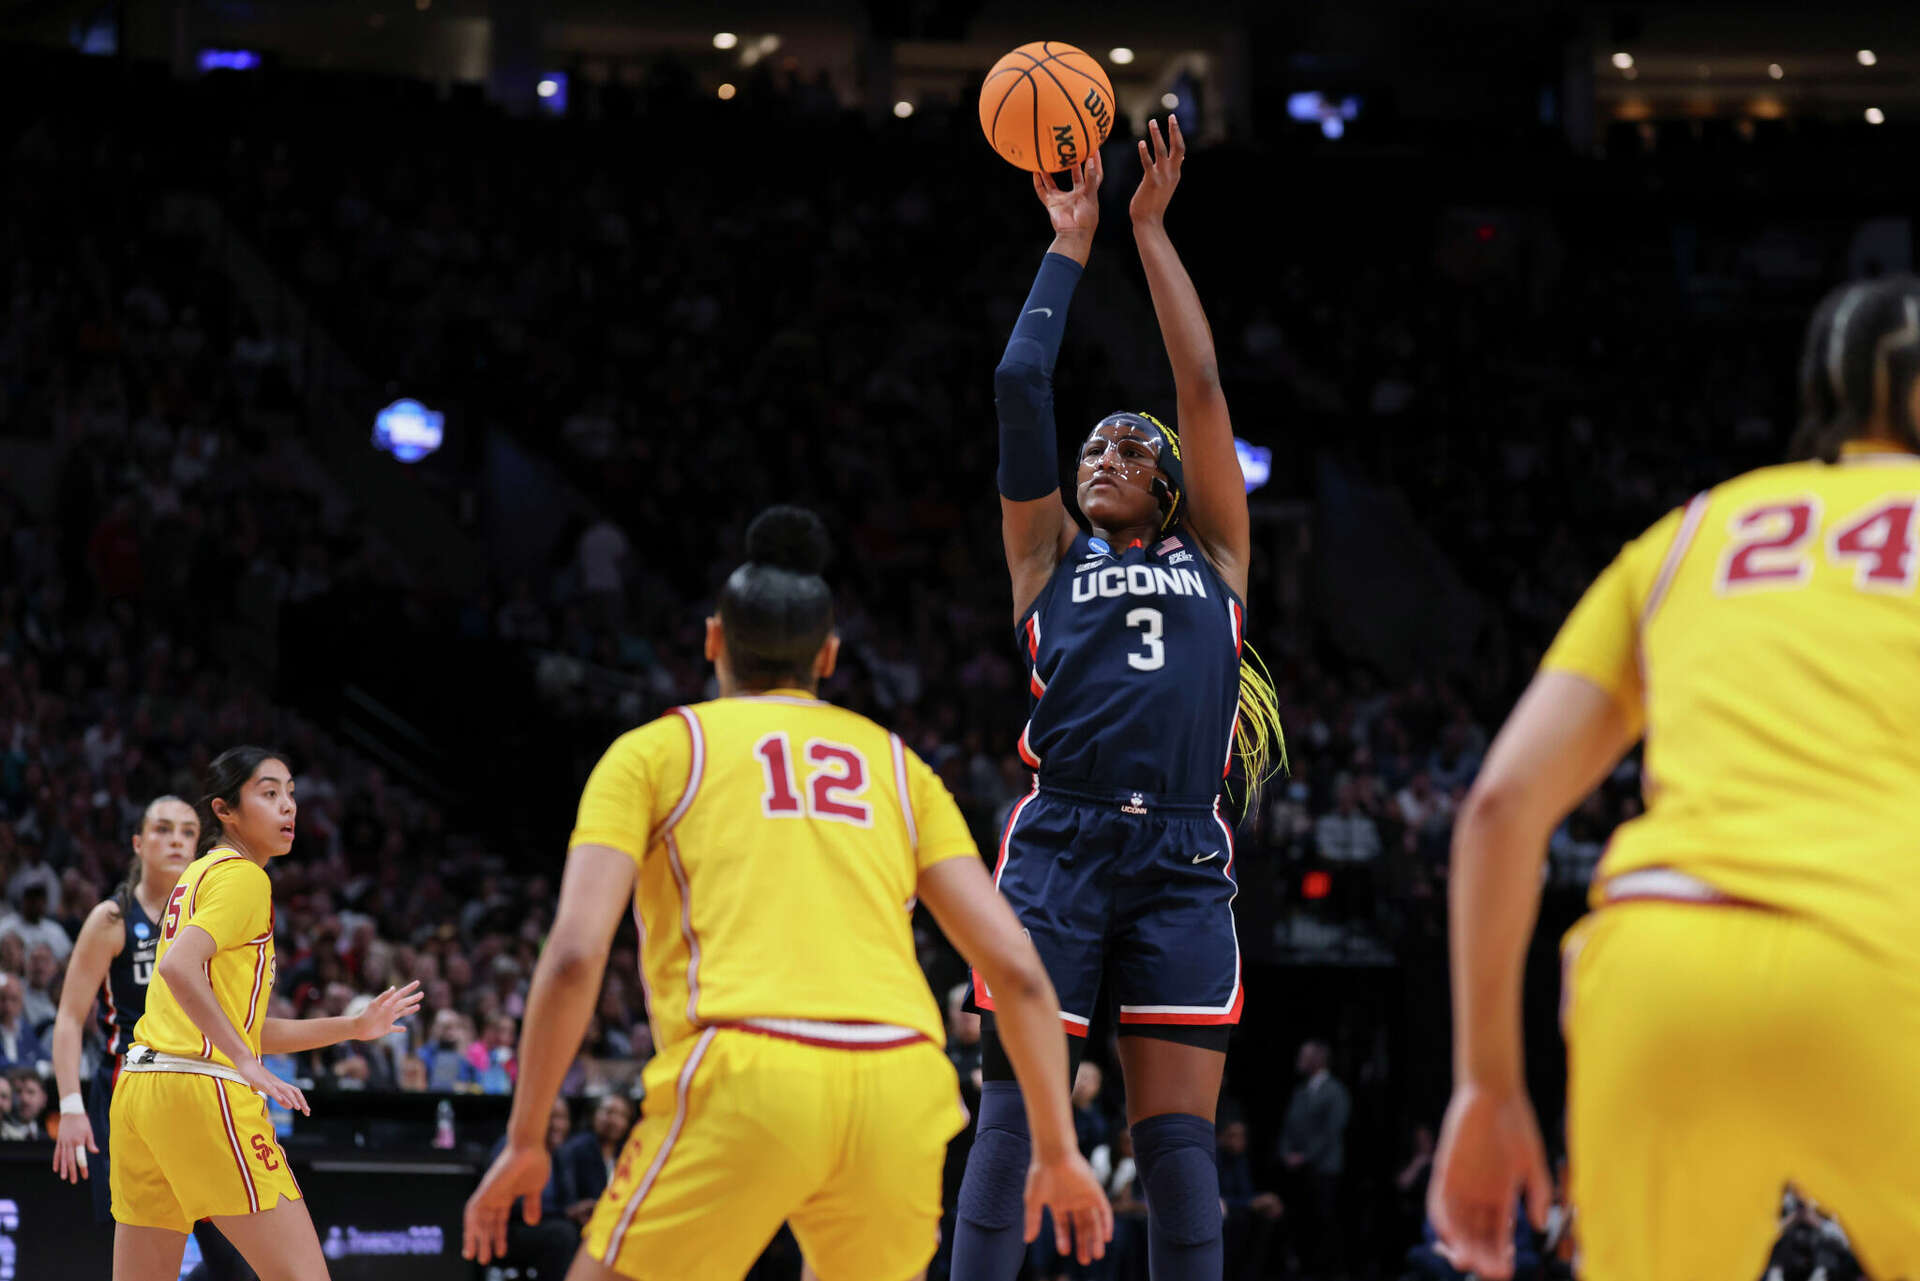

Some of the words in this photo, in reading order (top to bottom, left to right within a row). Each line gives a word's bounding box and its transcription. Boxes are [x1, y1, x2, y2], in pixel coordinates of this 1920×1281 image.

[1714, 492, 1918, 597] 24
[1072, 565, 1207, 602] UCONN
[1126, 607, 1165, 671] 3
[753, 731, 874, 829] 12
[1121, 804, 1148, 815] UCONN
